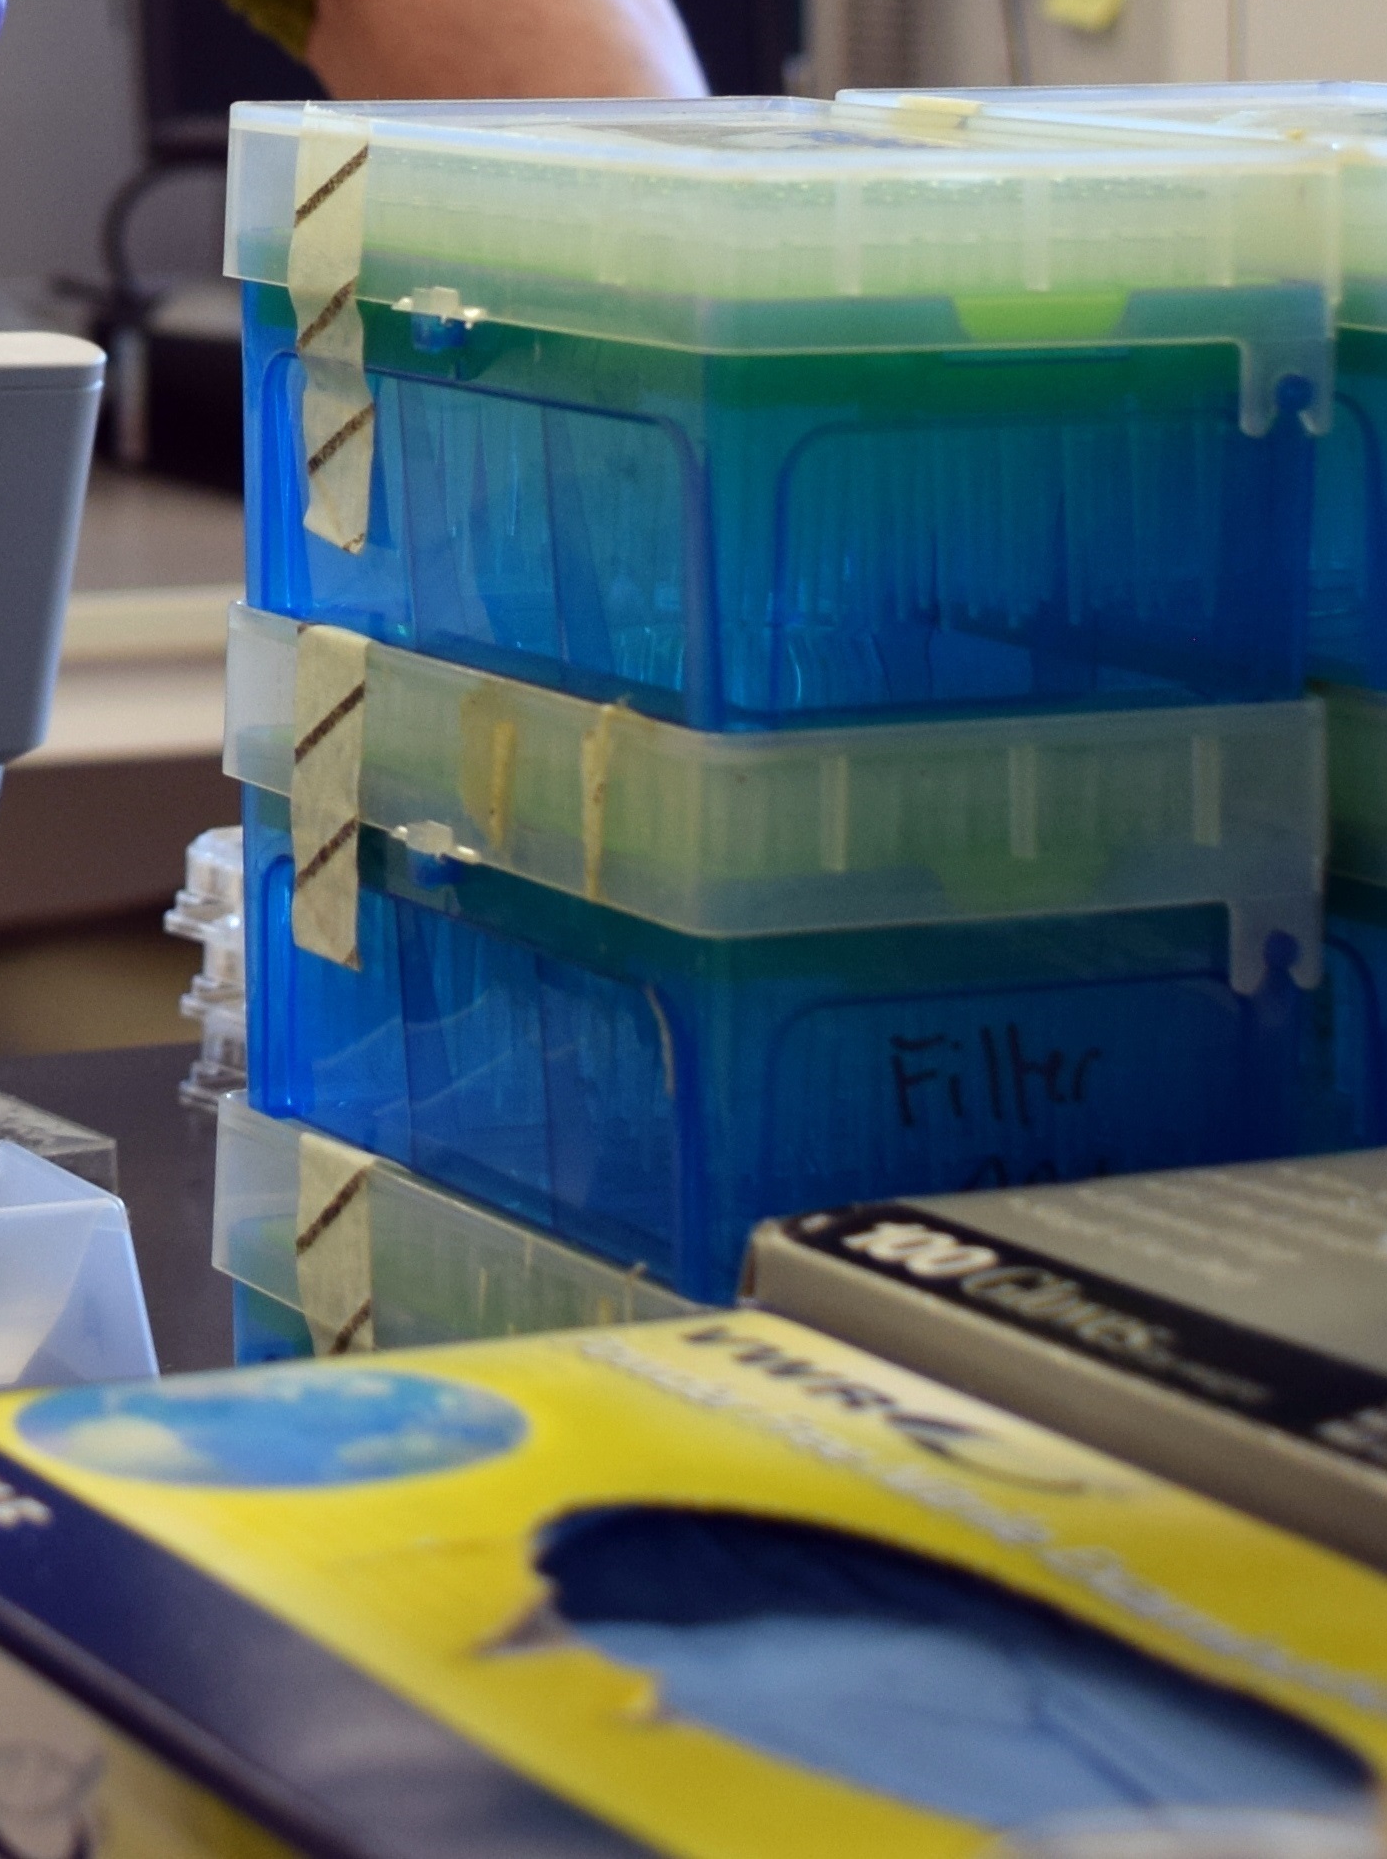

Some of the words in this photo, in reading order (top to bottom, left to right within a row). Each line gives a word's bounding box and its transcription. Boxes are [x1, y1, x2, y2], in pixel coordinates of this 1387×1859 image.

[888, 1021, 1103, 1127] Filter
[838, 1221, 999, 1280] 100
[682, 1324, 900, 1415] VWR
